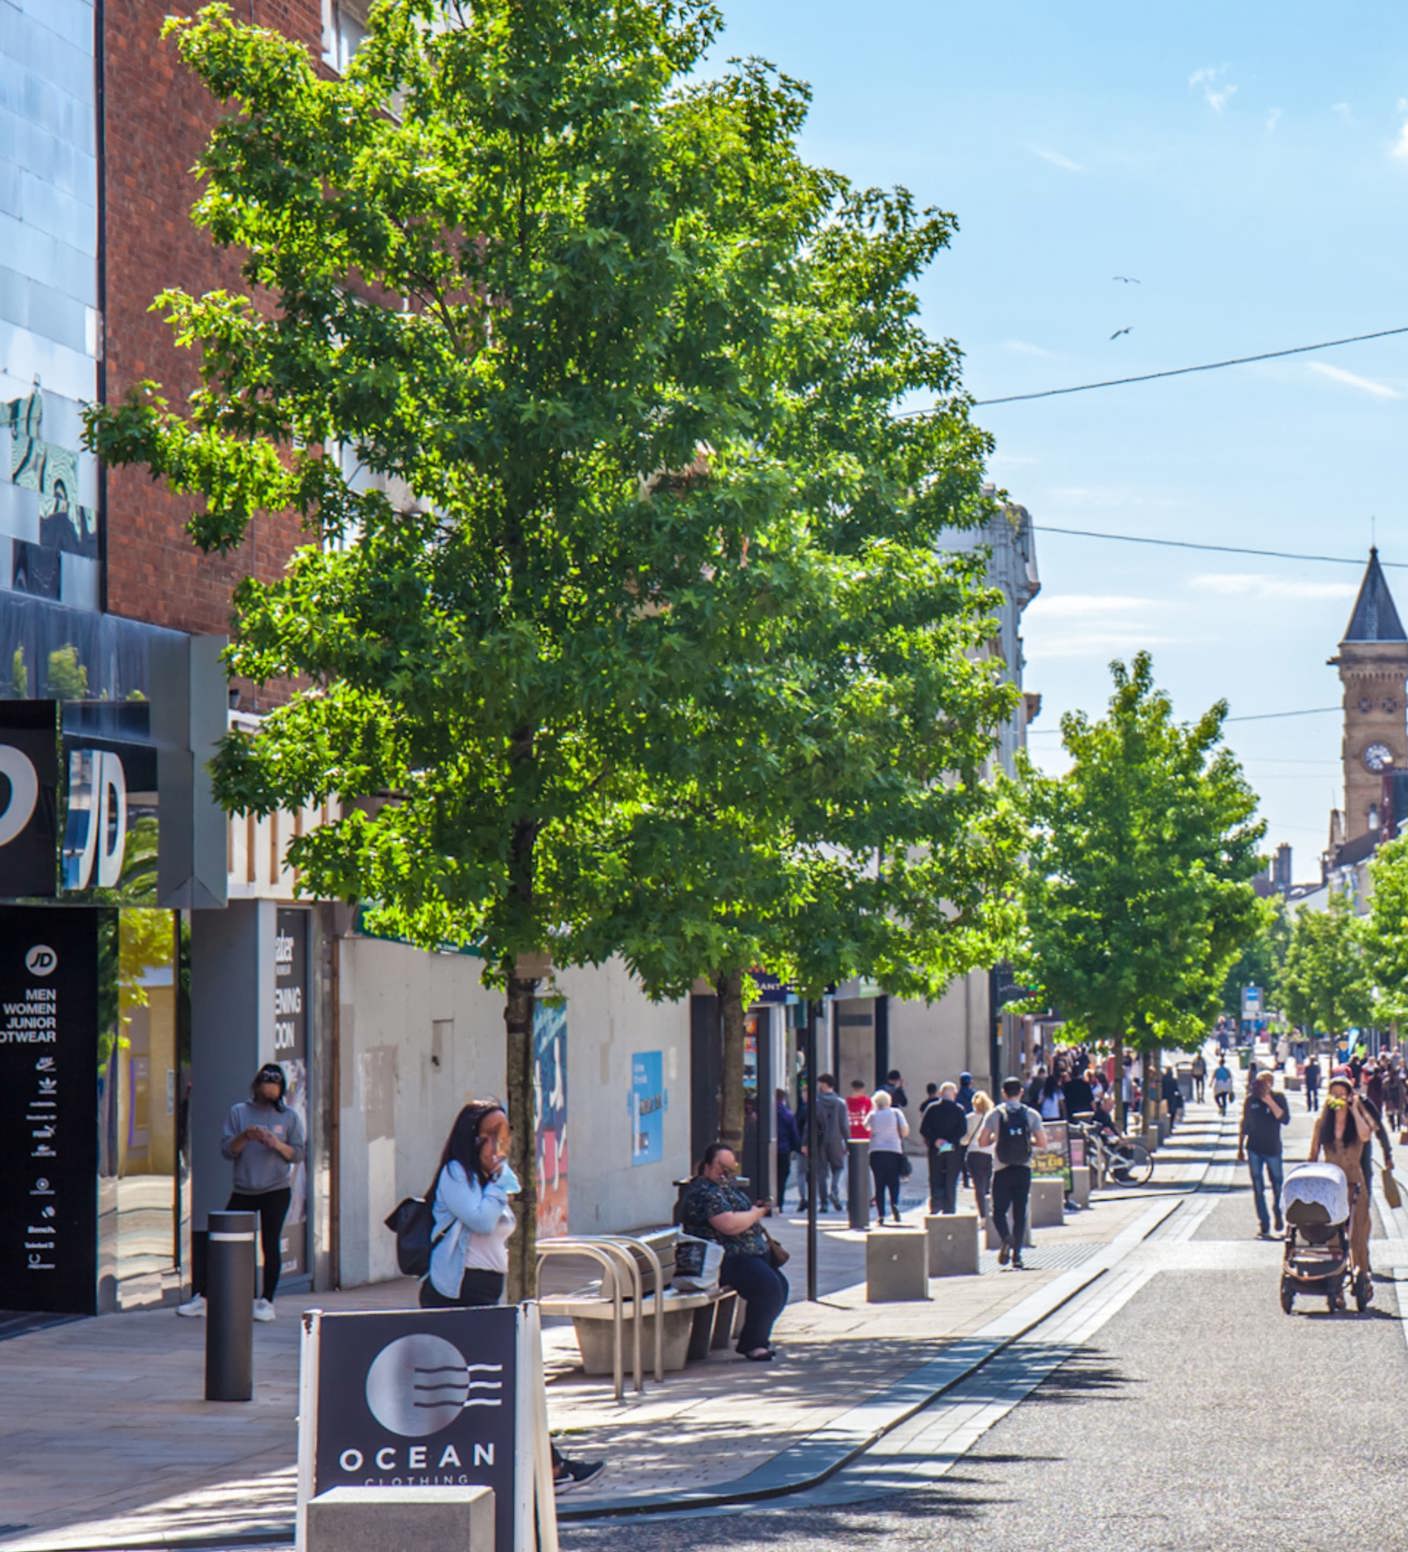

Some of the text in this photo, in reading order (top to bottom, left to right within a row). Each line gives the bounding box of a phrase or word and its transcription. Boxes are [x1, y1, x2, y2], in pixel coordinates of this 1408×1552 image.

[30, 952, 53, 968] JD
[25, 988, 57, 1001] MEN
[2, 1003, 57, 1015] WOMEN
[6, 1017, 57, 1029] JUNIOR
[339, 1443, 496, 1472] OCEAN
[364, 1474, 469, 1487] CLOTHING
